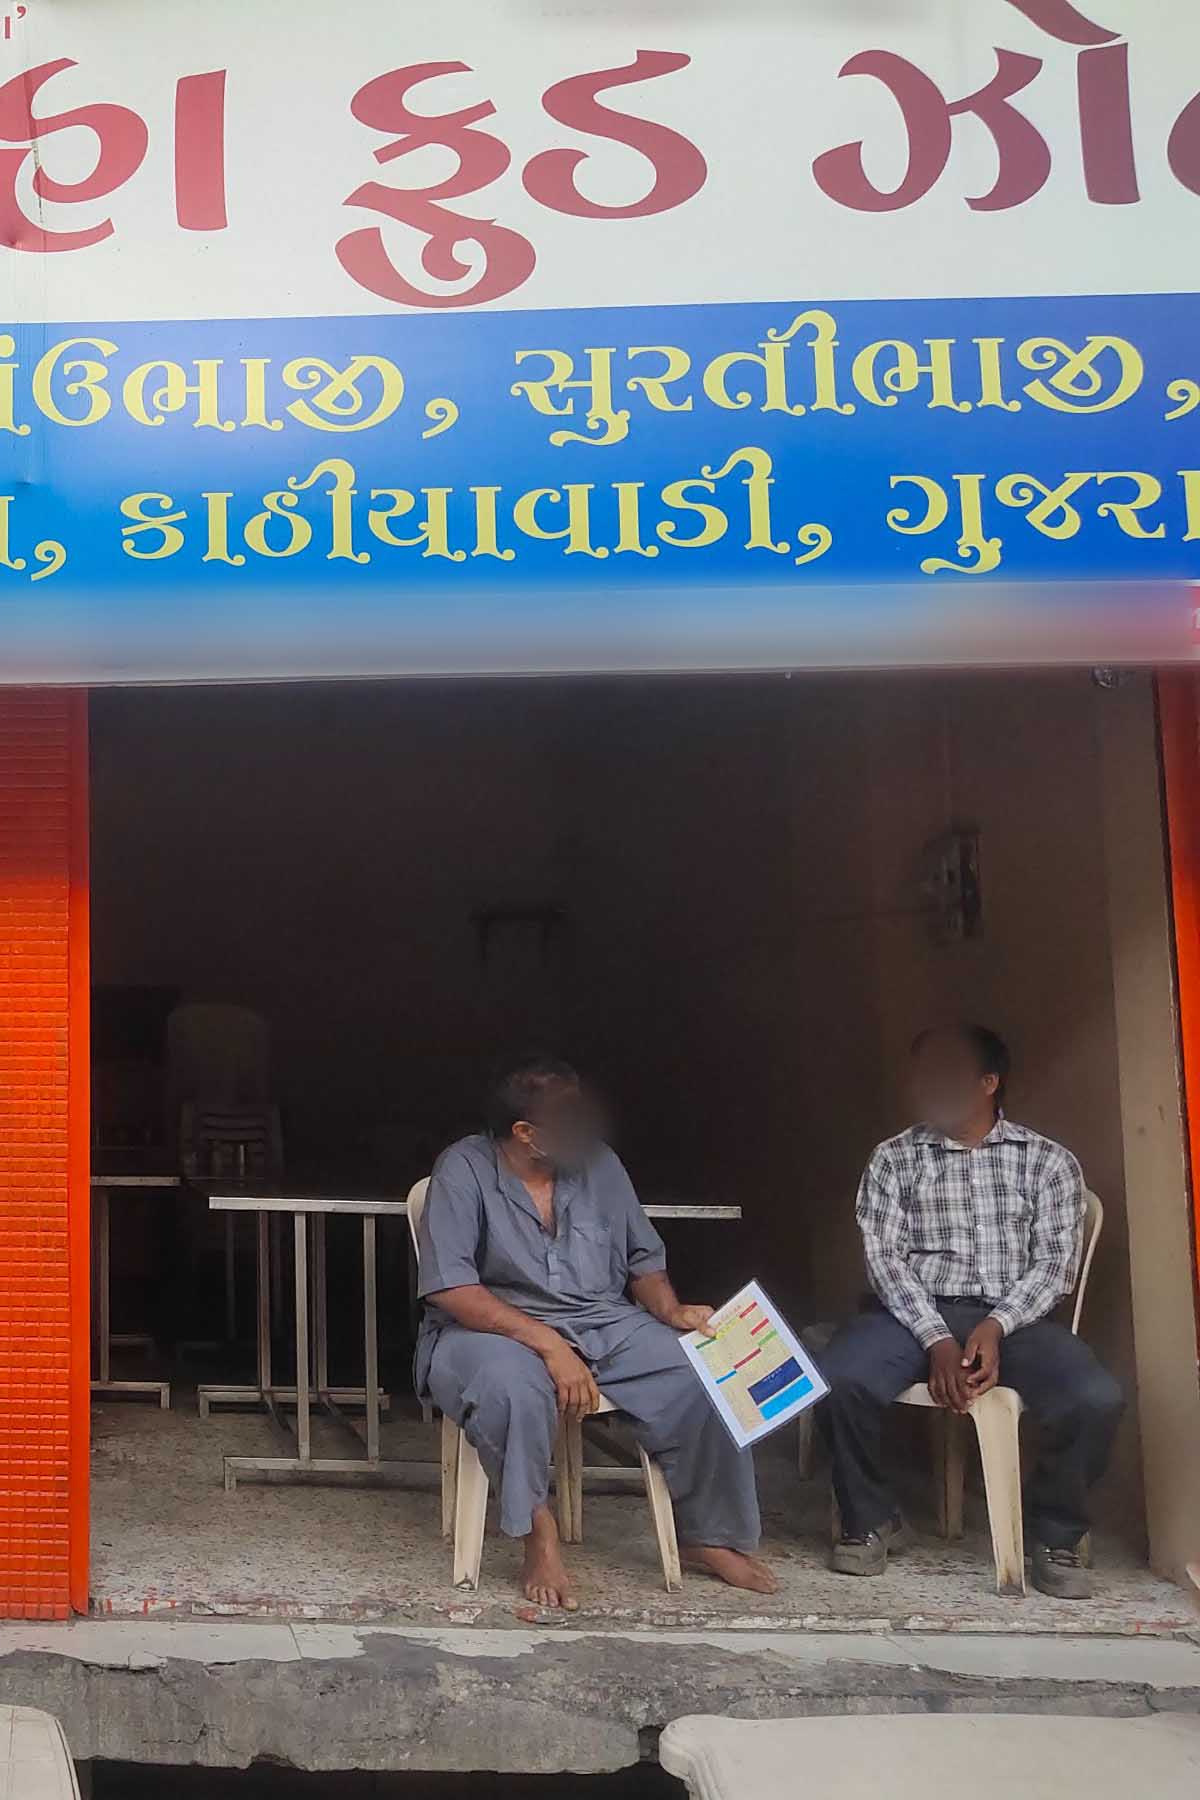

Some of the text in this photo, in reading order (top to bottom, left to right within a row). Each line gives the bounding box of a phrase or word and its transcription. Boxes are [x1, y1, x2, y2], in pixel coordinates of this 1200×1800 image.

[336, 50, 707, 308] ફુડ
[511, 311, 1200, 446] સુરતીભાજી,
[121, 450, 832, 565] કાઠીયાવાડી,
